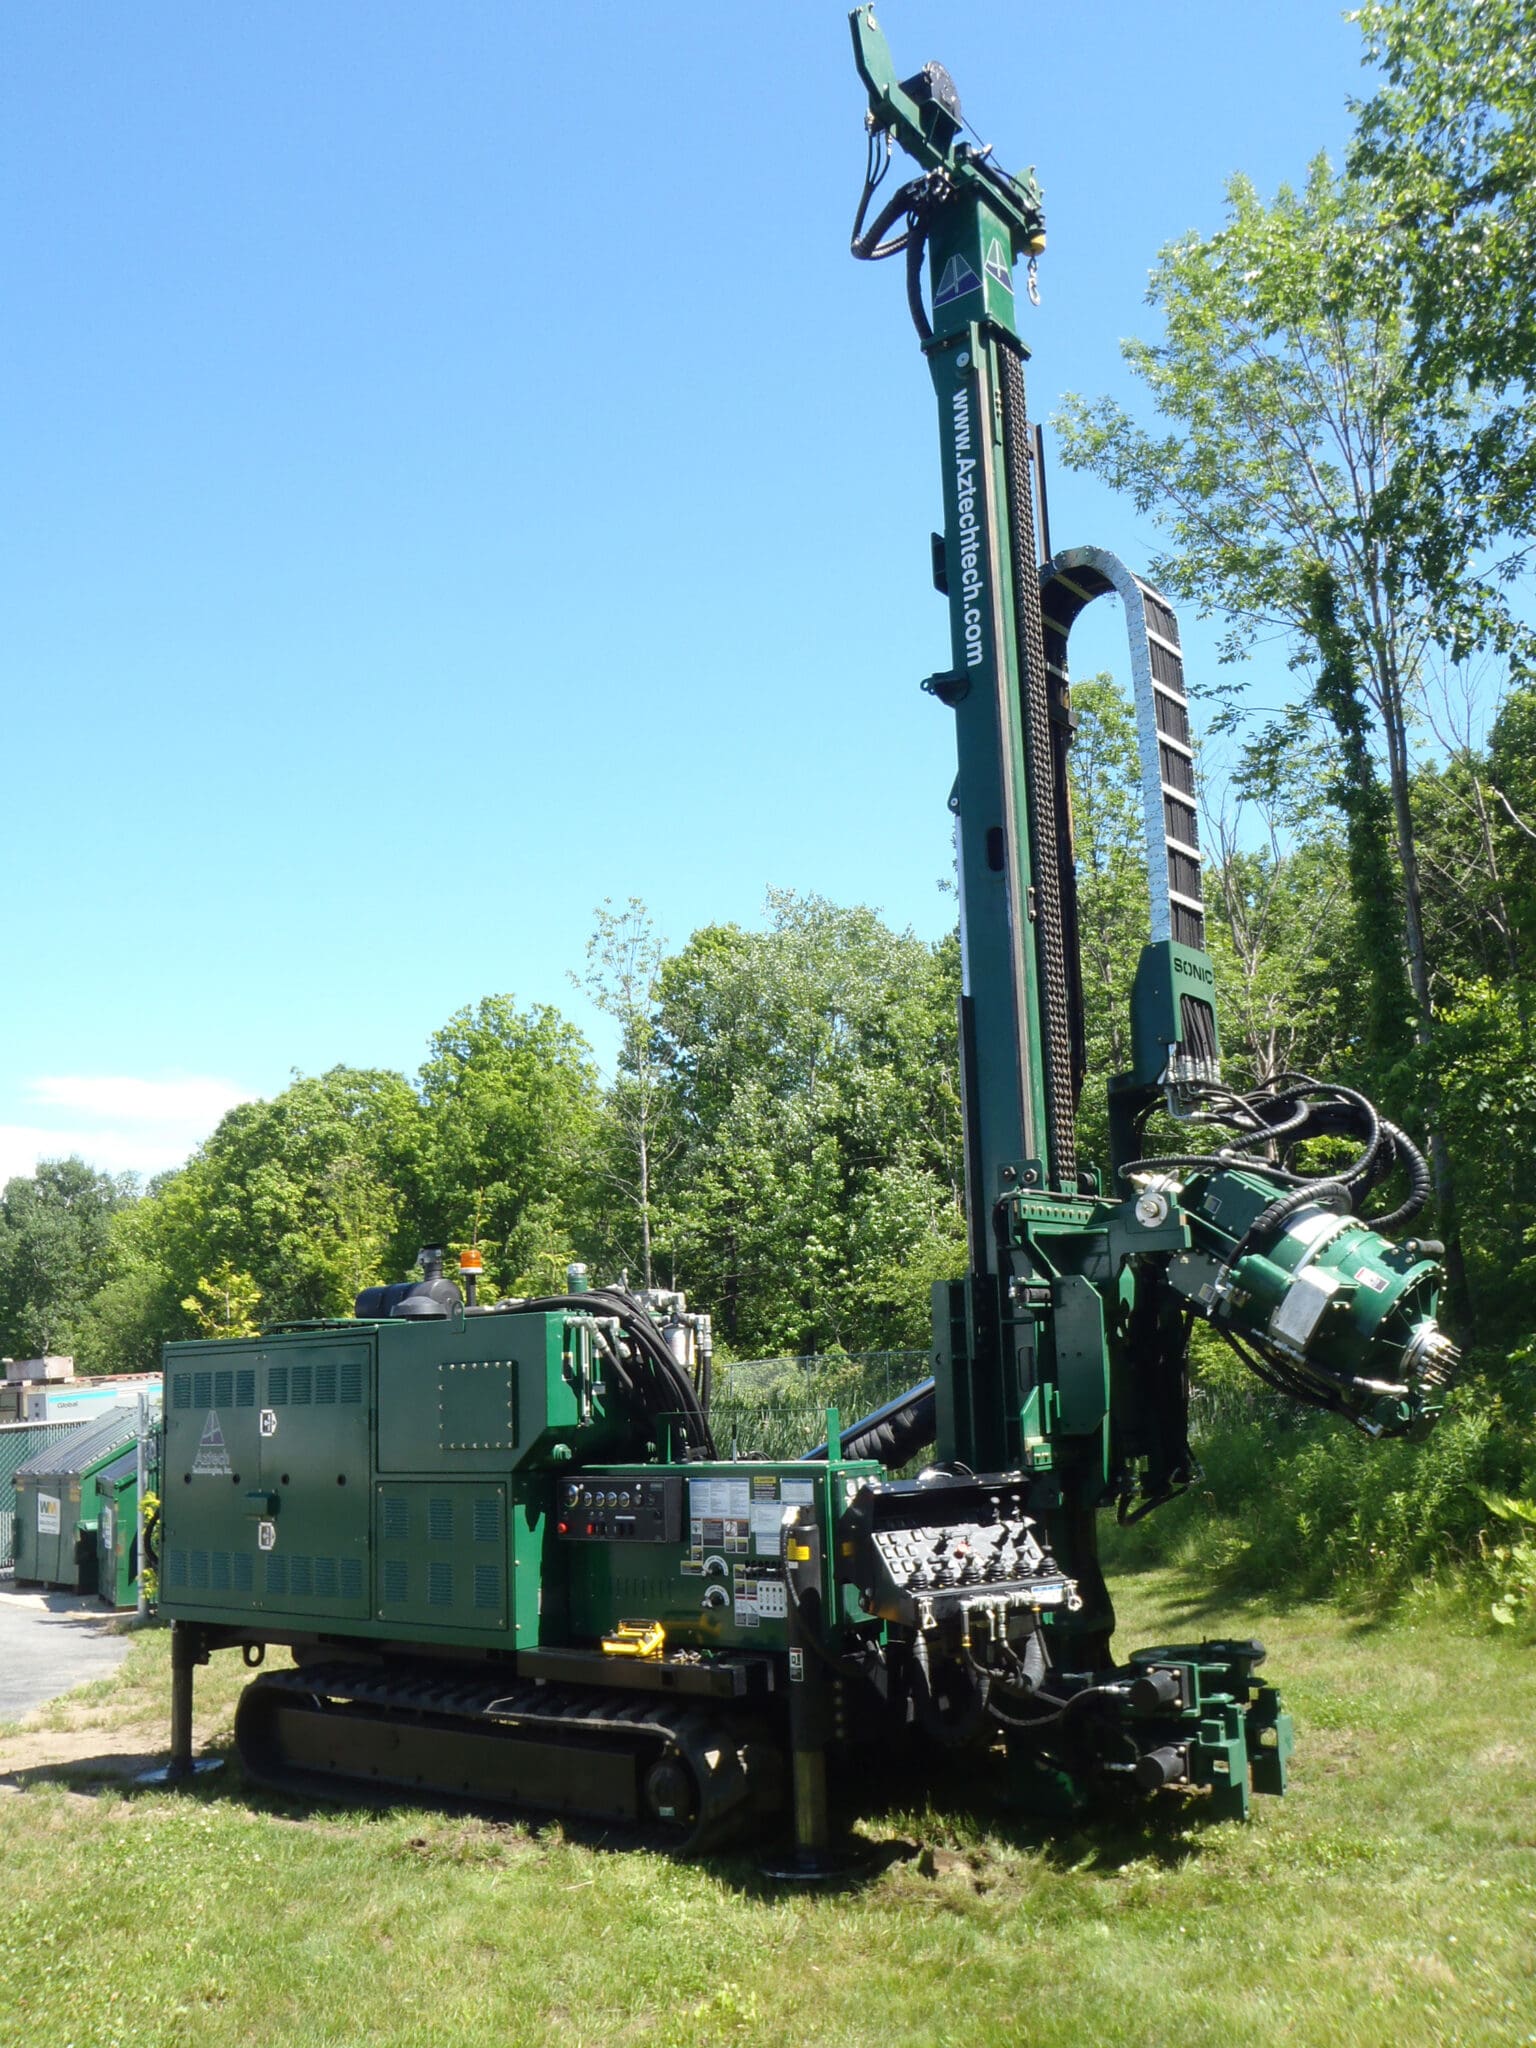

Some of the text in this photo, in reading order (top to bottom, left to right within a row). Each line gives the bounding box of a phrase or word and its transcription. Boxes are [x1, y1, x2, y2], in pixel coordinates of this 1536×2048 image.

[952, 388, 984, 667] www.Aztechtech.com
[1174, 957, 1213, 985] SONIC
[194, 1448, 230, 1465] Aztech
[40, 1501, 57, 1515] WM
